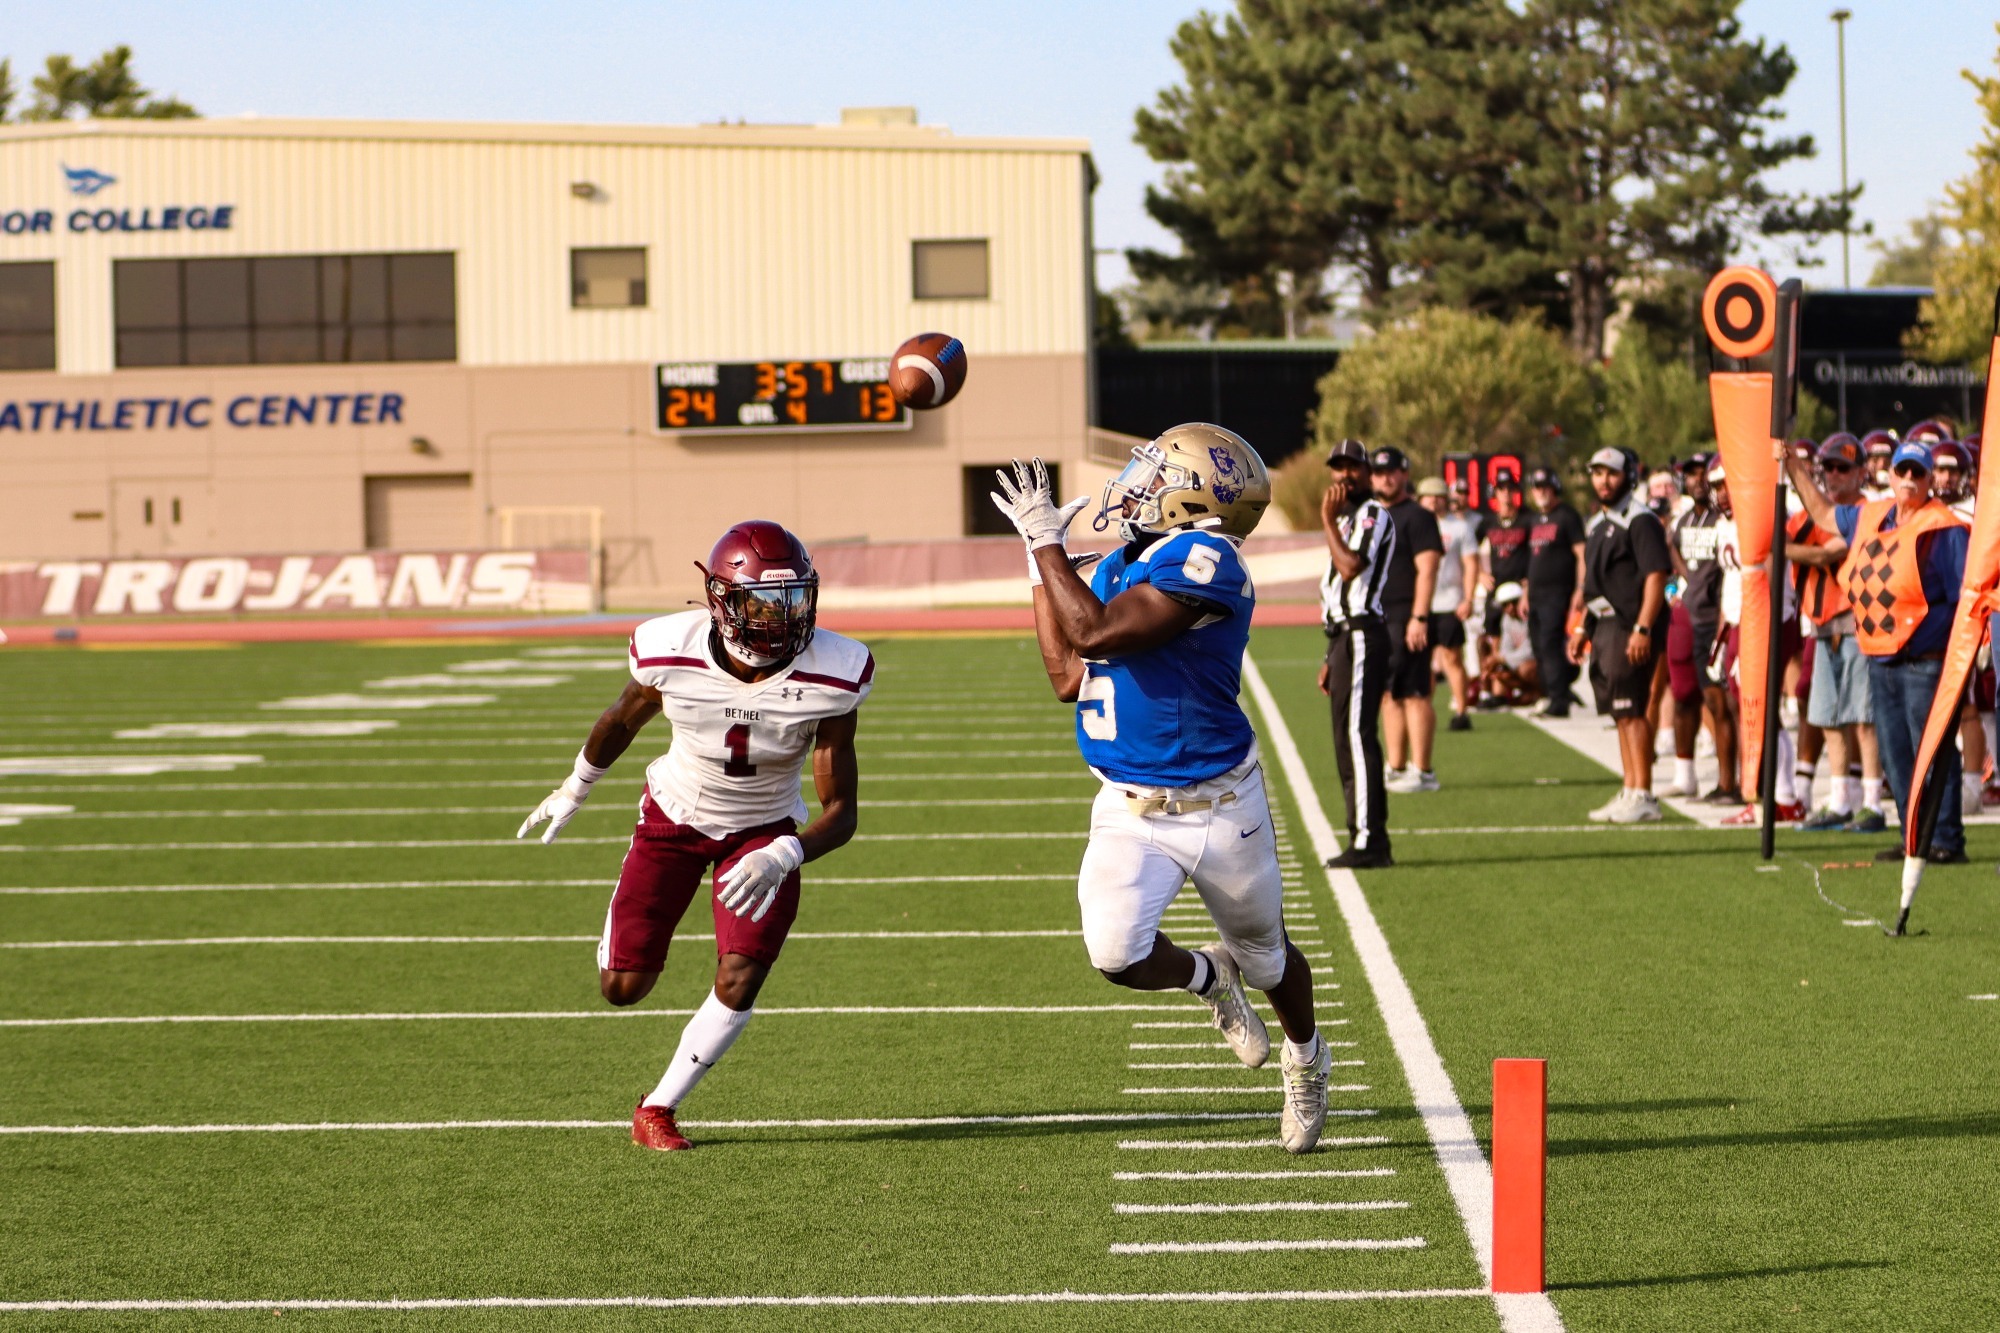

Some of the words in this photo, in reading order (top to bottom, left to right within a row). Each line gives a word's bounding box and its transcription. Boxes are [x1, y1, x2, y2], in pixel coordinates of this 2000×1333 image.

[0, 209, 53, 234] OR
[67, 204, 235, 233] COLLEGE
[661, 364, 719, 387] HOME
[756, 360, 834, 401] 3:57
[840, 359, 891, 382] GUES
[0, 396, 213, 431] ATHLETIC
[225, 392, 406, 427] CENTER
[665, 387, 717, 427] 24
[785, 399, 808, 425] 4
[859, 383, 897, 422] 13
[1182, 542, 1222, 585] 5
[37, 552, 538, 616] TROJANS
[725, 707, 761, 721] BETHEL
[1077, 657, 1118, 742] 5
[723, 722, 758, 778] 1
